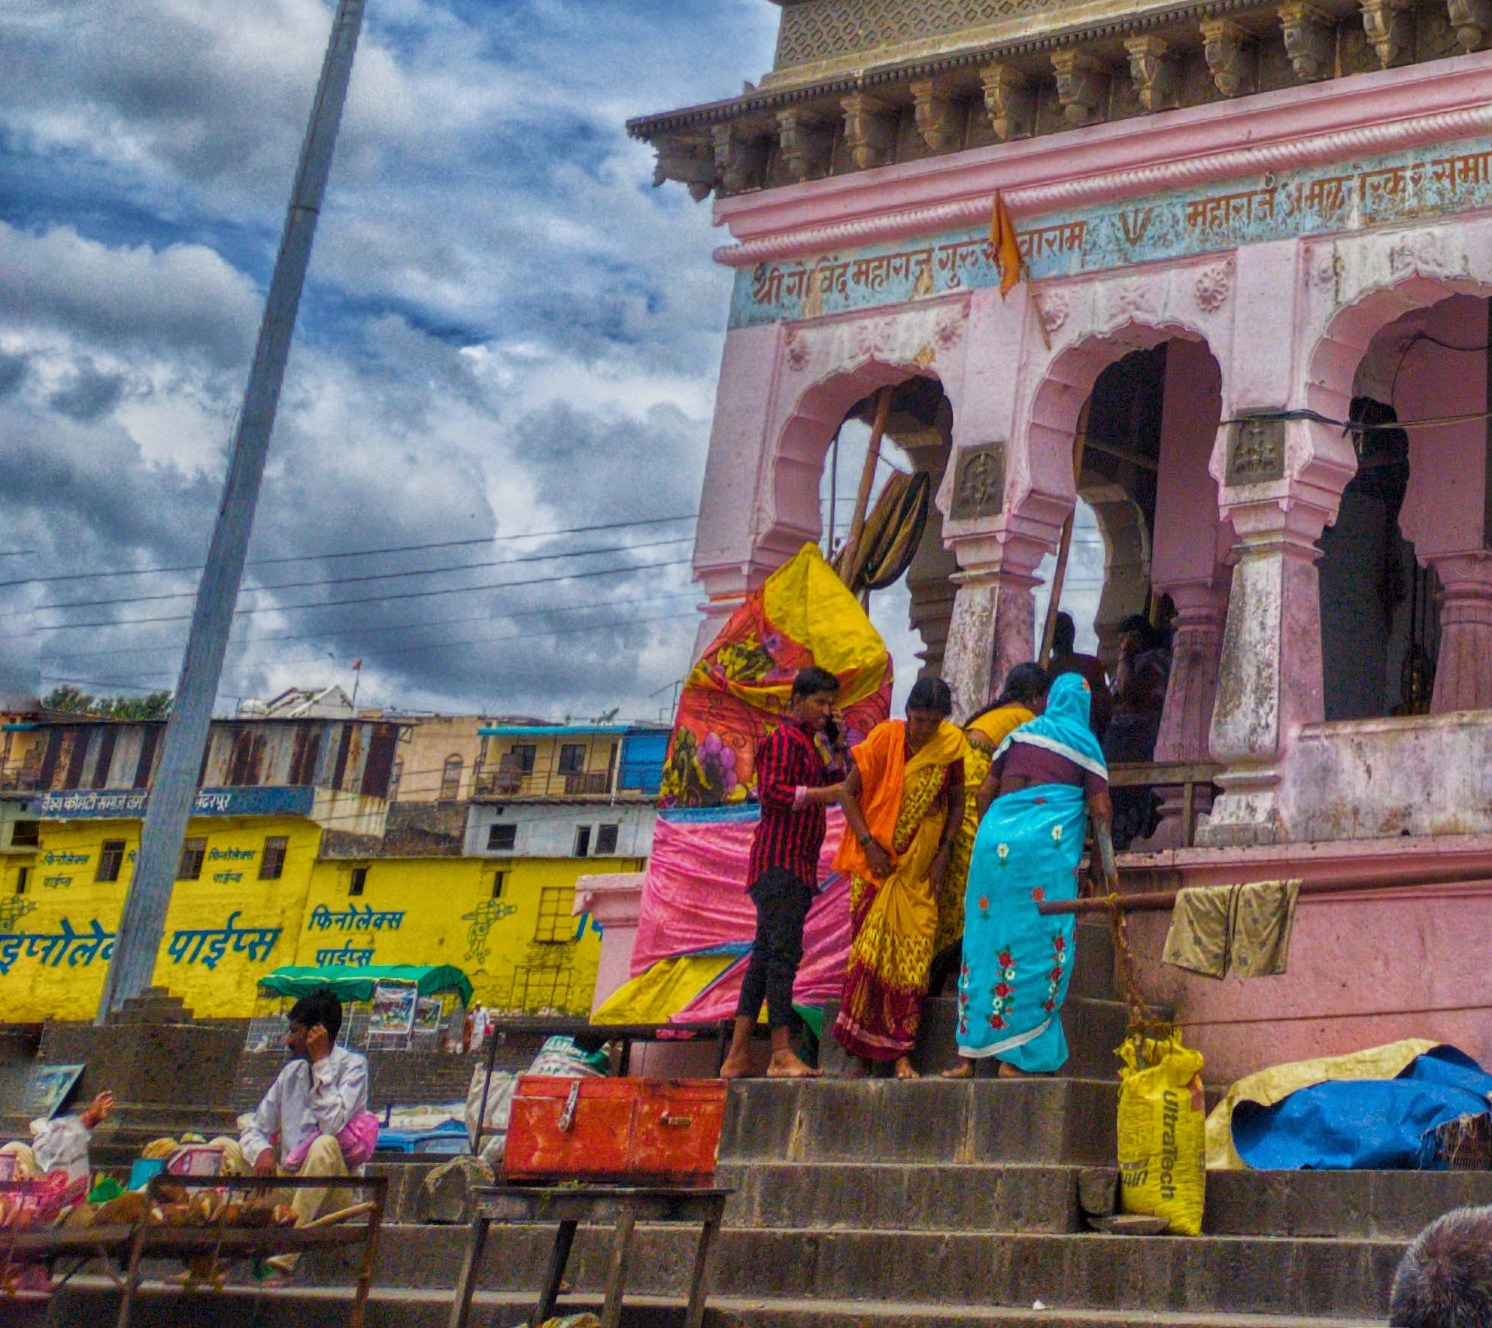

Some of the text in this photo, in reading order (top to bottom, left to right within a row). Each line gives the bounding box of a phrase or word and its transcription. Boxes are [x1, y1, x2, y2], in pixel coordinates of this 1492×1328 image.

[752, 263, 784, 305] श्री
[308, 903, 405, 931] फिनोलेक्स
[168, 910, 283, 970] पाईप्स
[316, 939, 376, 967] पाईप्स
[1161, 1090, 1178, 1201] UltraTech
